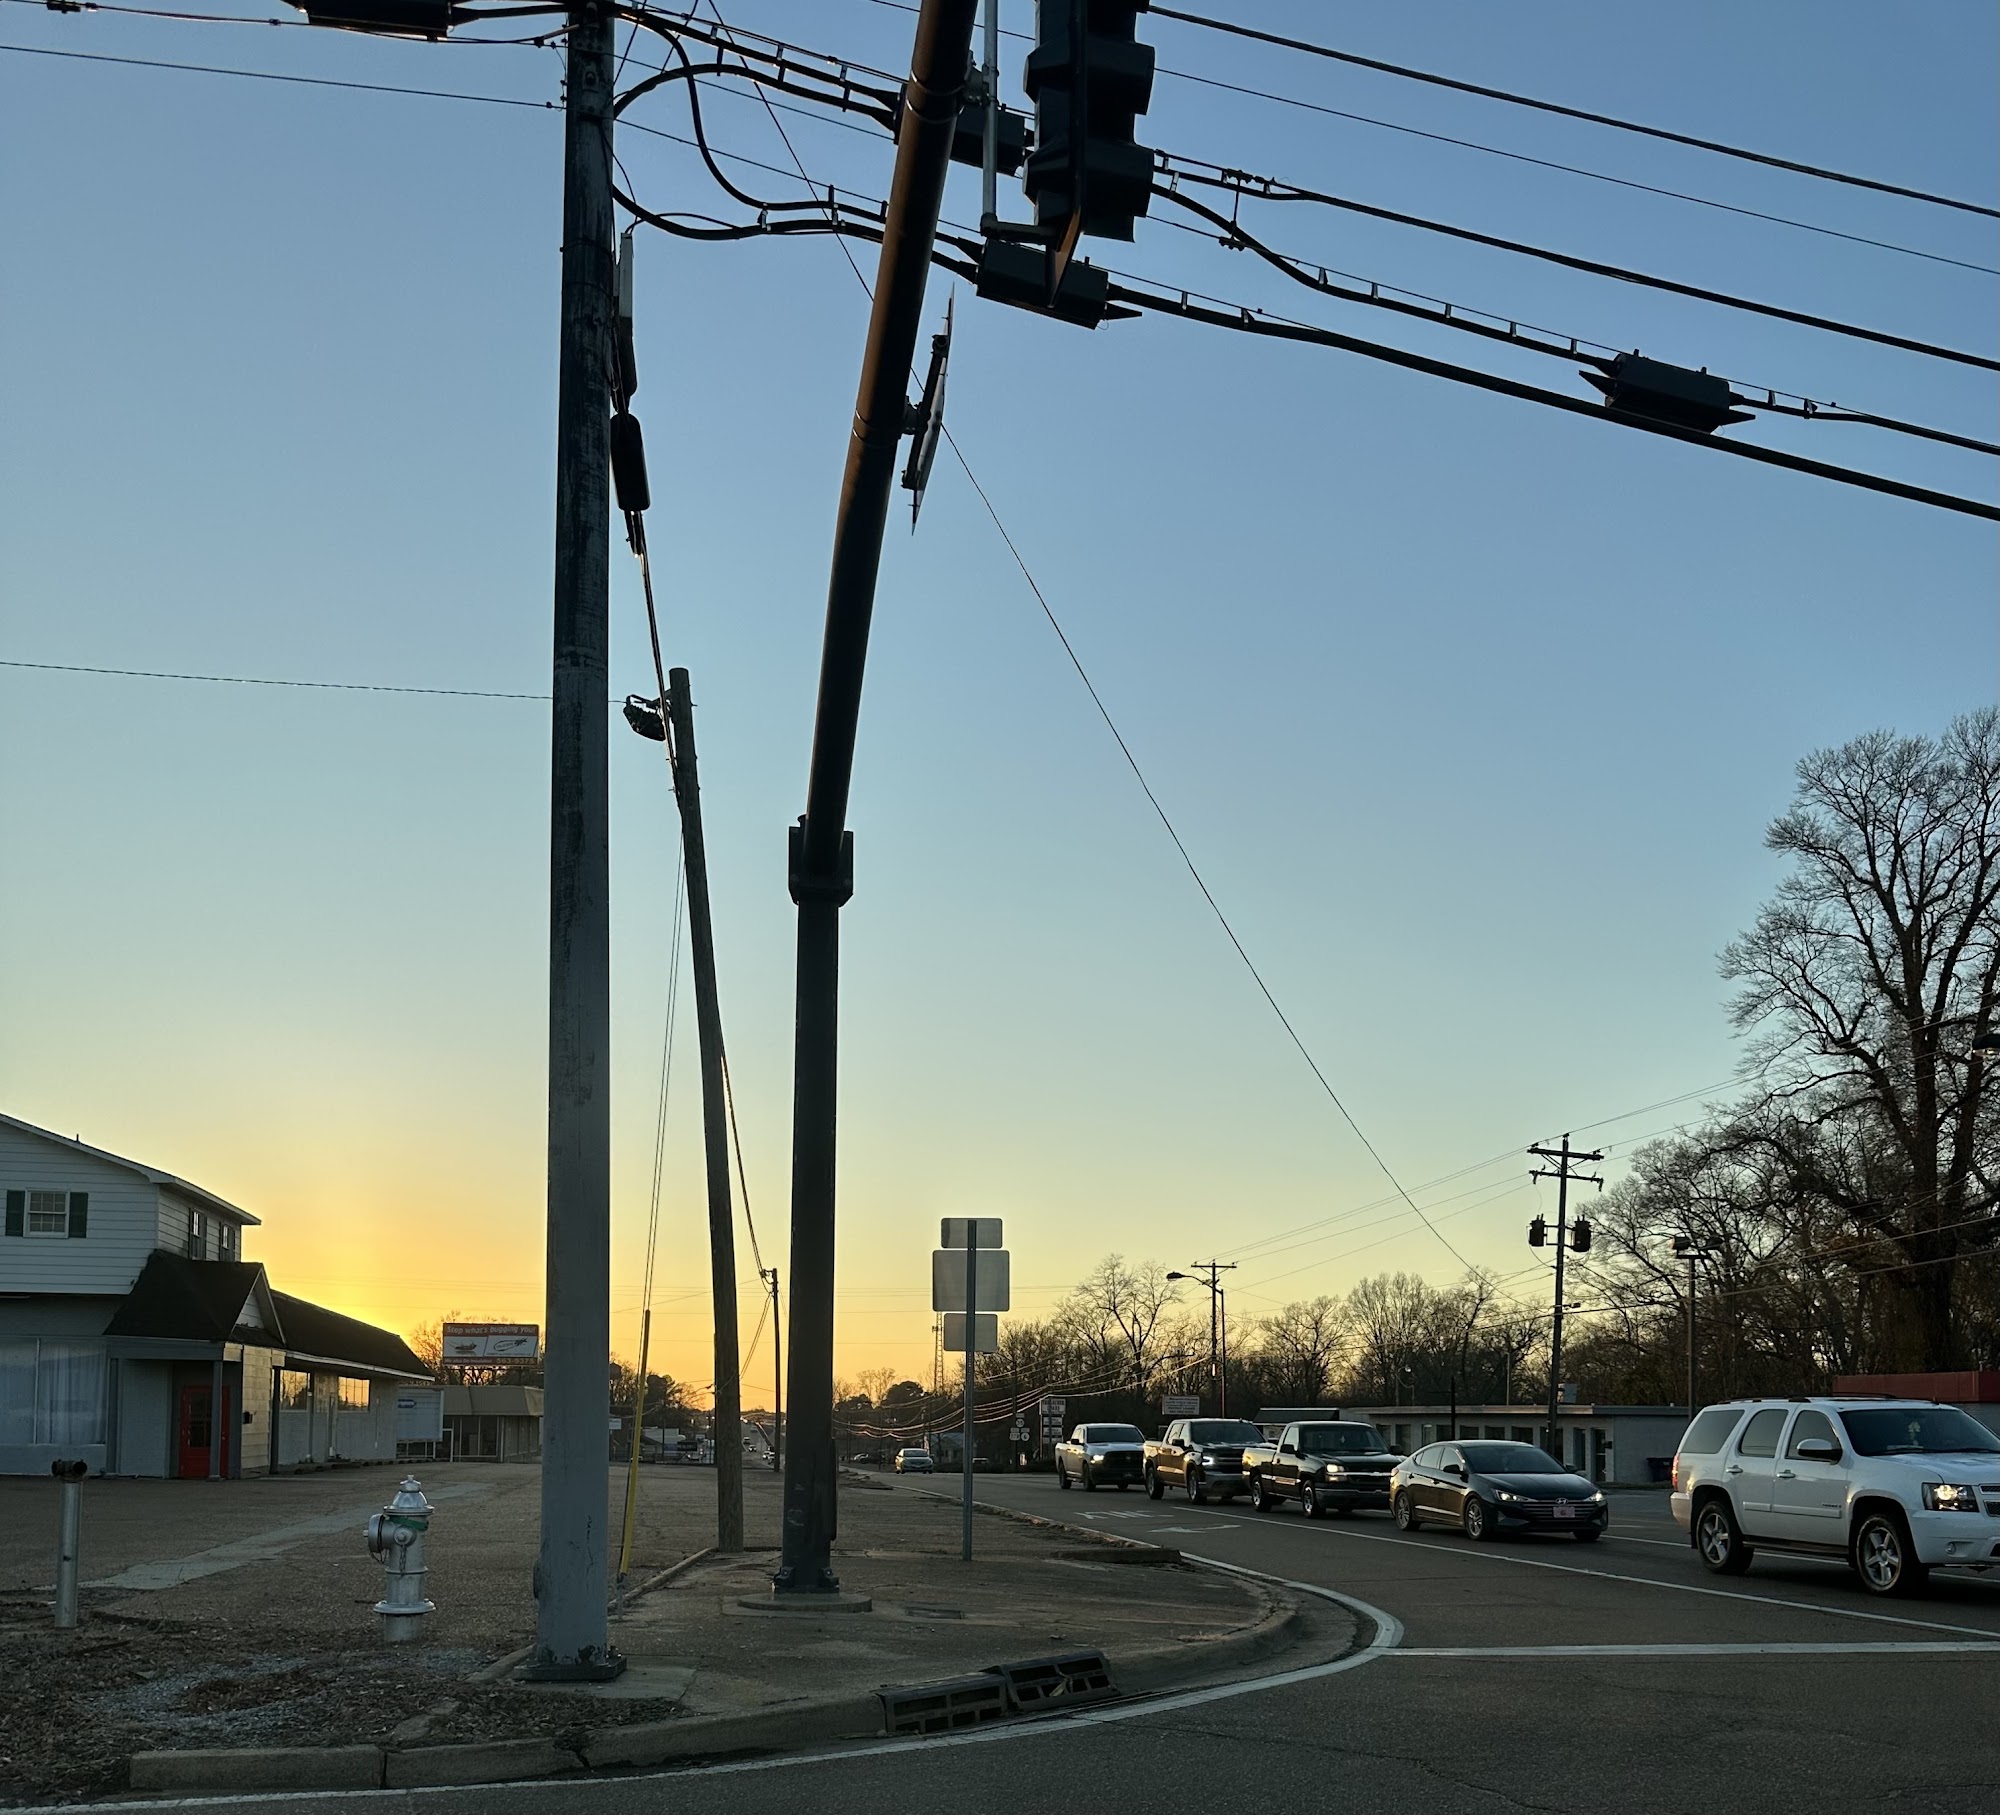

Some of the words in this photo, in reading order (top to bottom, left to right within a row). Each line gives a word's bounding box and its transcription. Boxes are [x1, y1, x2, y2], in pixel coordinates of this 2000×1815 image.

[446, 1326, 463, 1334] Stop
[465, 1326, 488, 1334] what's
[490, 1326, 518, 1334] bugging
